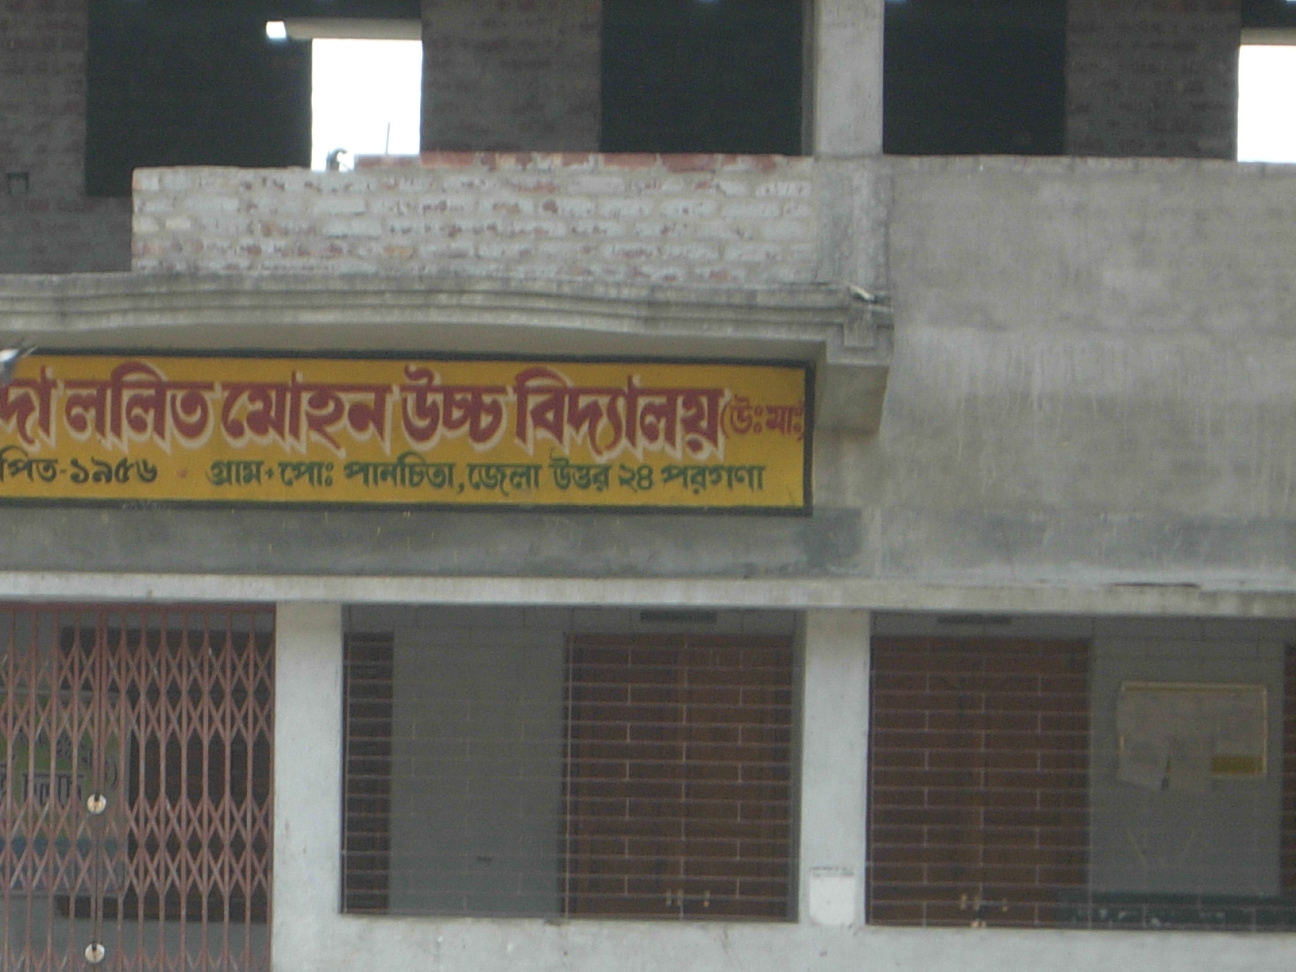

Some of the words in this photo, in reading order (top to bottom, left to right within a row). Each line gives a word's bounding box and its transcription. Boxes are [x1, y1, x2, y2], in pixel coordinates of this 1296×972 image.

[62, 361, 218, 450] ললিত
[220, 369, 396, 456] মোহন
[402, 364, 509, 450] উচ্চ
[513, 366, 729, 461] বিদ্যালয়
[548, 447, 613, 493] উত্তর
[617, 462, 655, 494] ২৪
